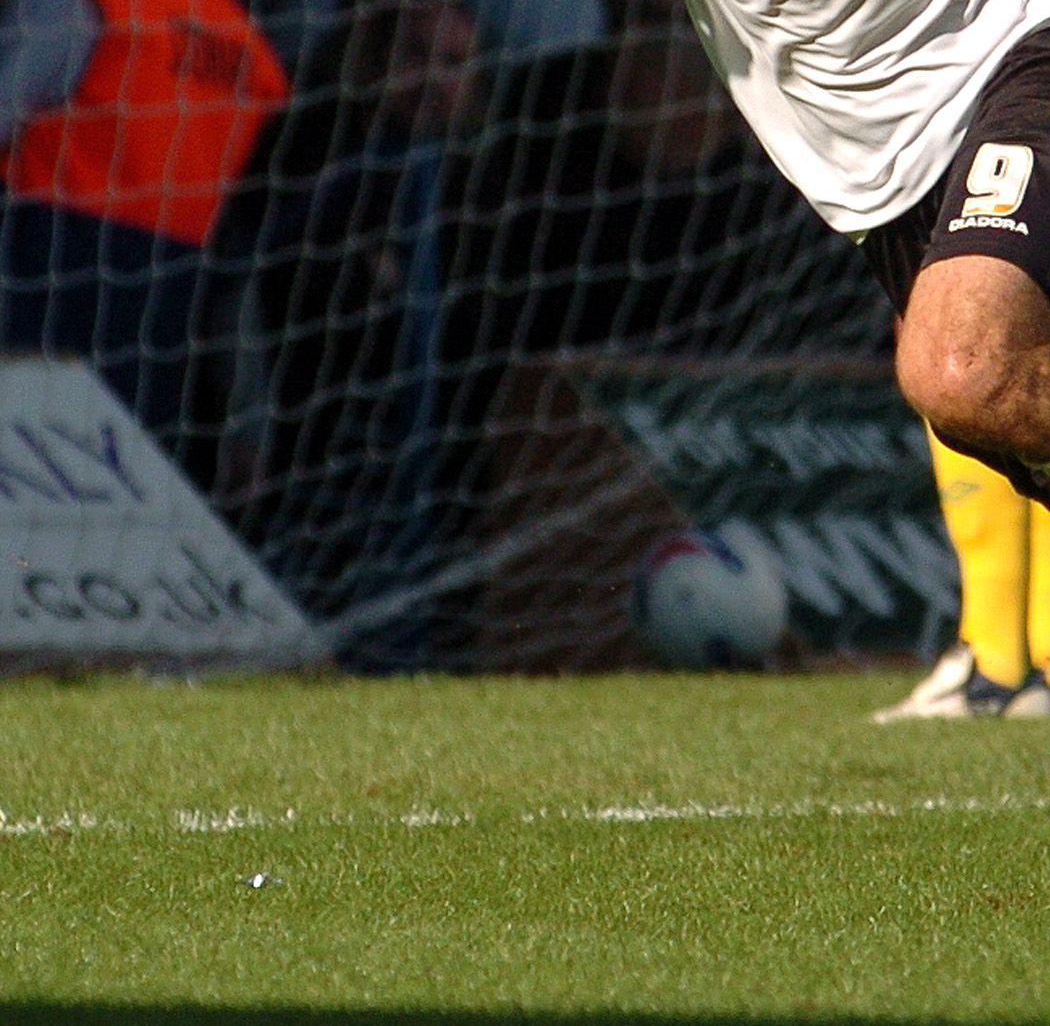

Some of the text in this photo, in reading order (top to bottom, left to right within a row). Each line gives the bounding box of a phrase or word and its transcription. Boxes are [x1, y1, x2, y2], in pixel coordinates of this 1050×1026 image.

[961, 142, 1034, 218] 9
[948, 216, 1029, 236] DIADORA
[12, 539, 277, 623] .co.uk
